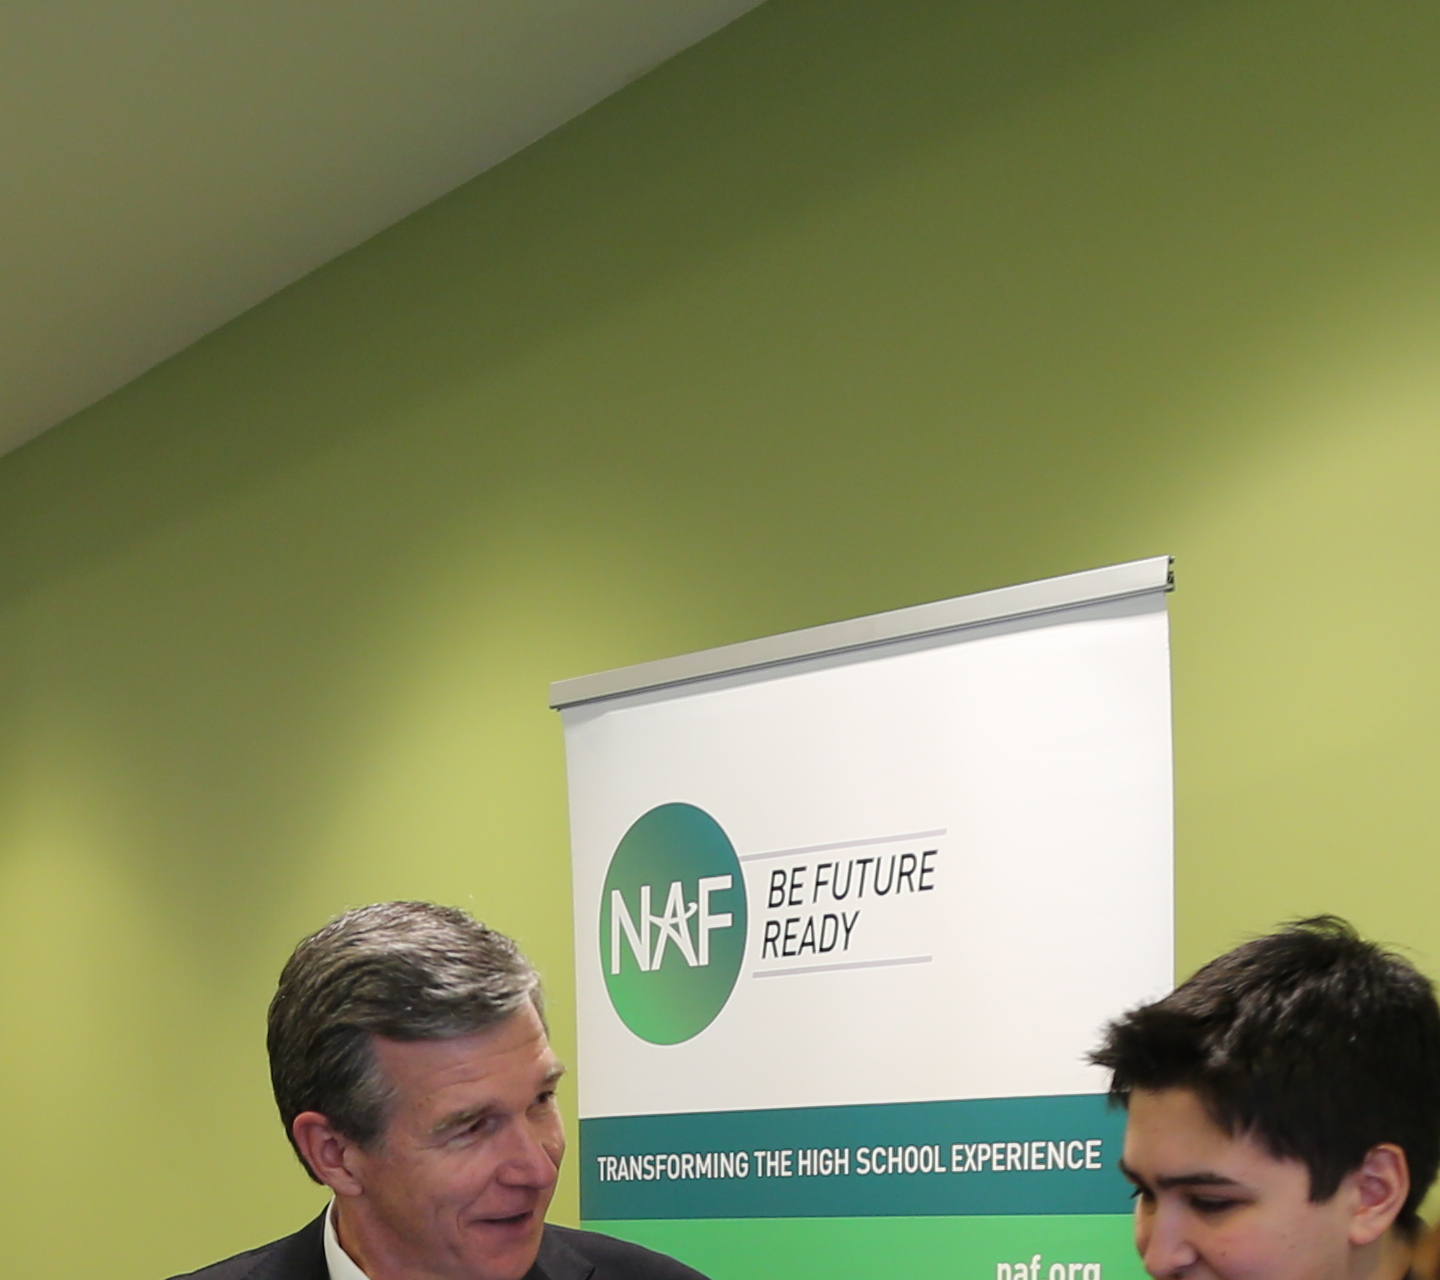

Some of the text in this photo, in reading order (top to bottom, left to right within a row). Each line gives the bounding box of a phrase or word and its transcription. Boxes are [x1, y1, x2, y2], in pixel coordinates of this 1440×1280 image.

[767, 849, 940, 910] BE FUTURE
[610, 873, 734, 976] NAF
[761, 910, 861, 960] READY
[597, 1139, 1103, 1182] TRANSFORMING THE HIGH SCHOOL EXPERIENCE
